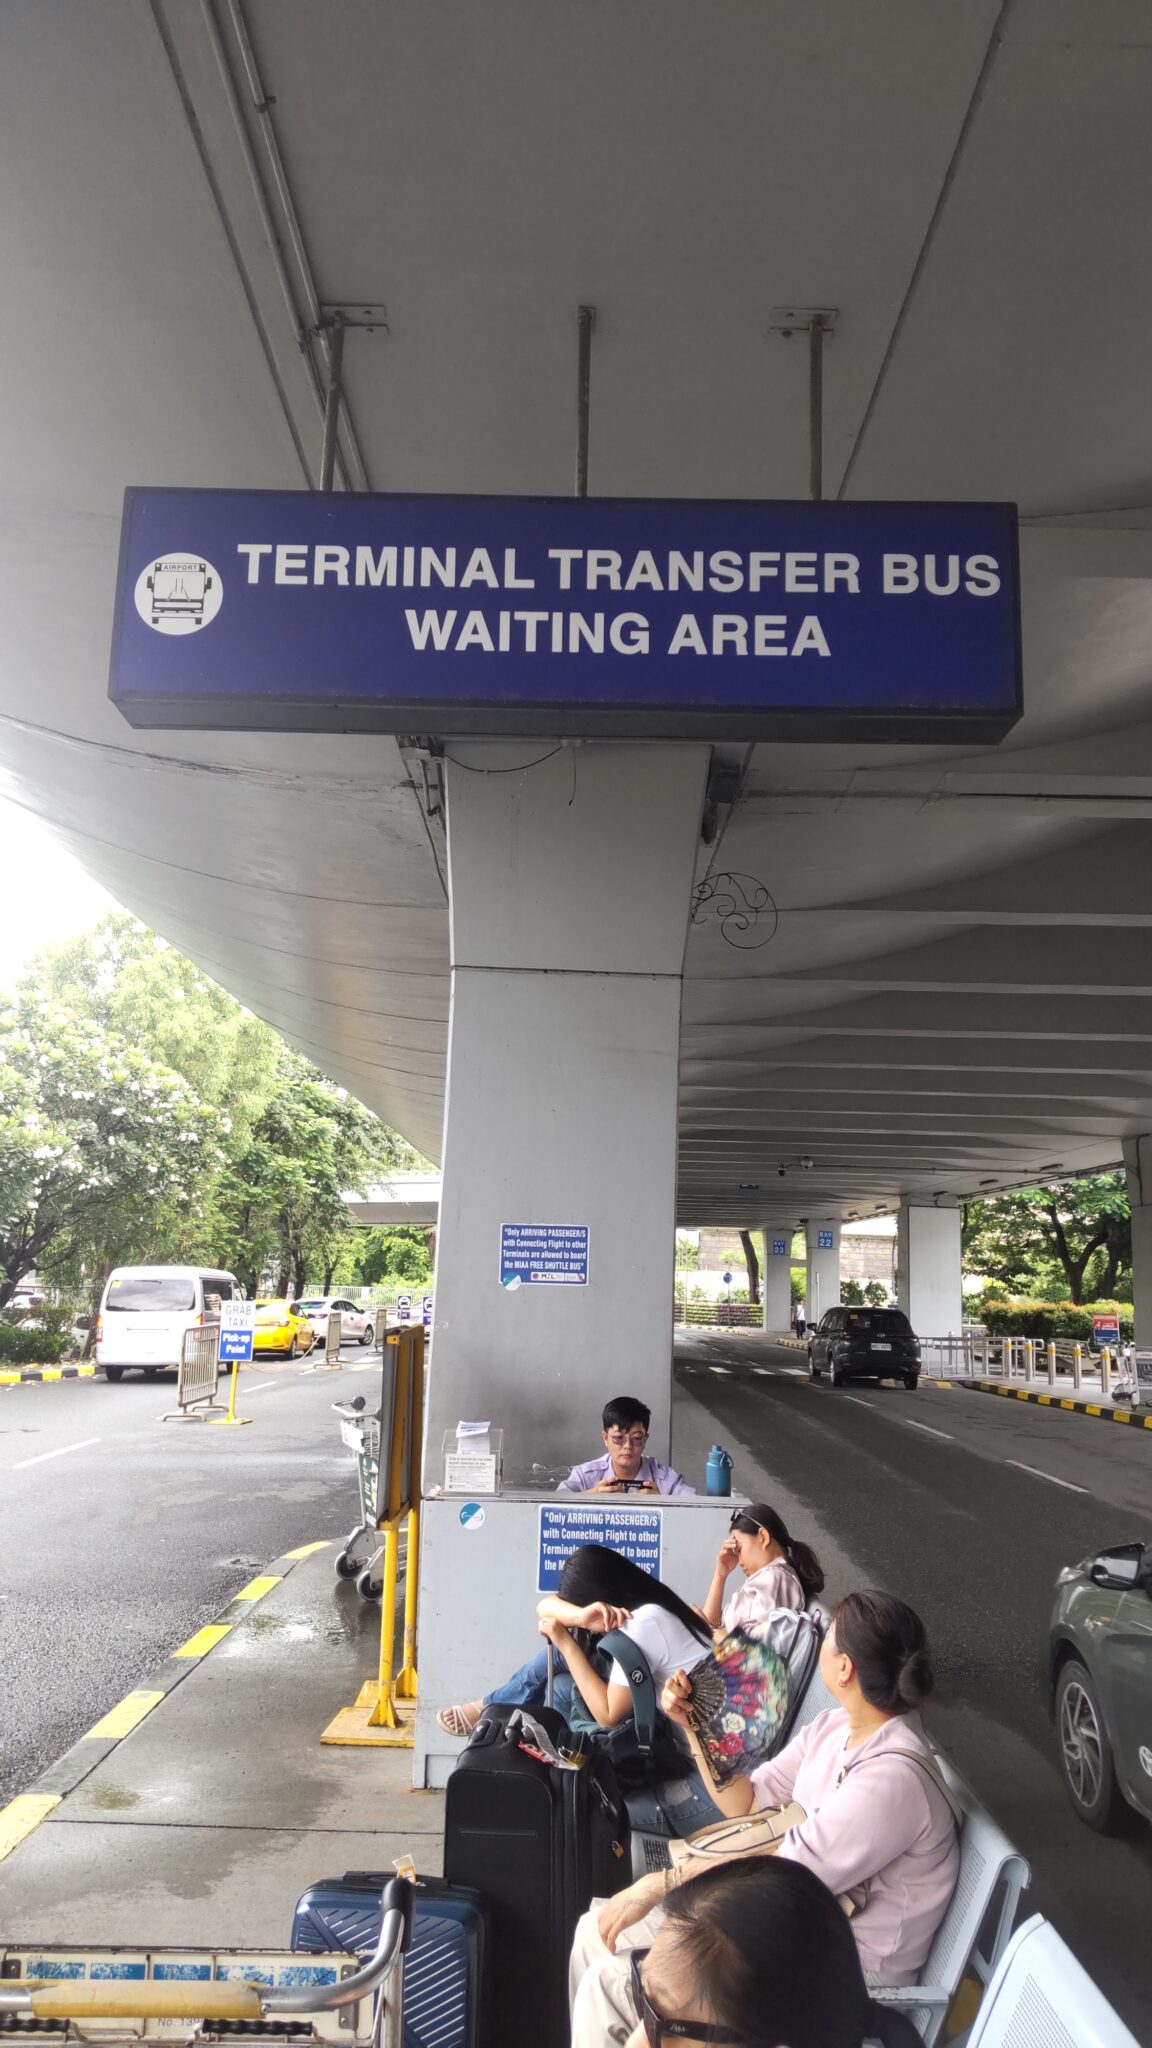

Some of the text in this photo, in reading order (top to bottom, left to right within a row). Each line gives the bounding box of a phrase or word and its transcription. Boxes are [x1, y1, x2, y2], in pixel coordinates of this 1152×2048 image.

[237, 543, 1001, 597] TERMINAL TRANSFER BUS
[404, 609, 832, 657] WAITING AREA
[520, 1228, 547, 1237] ARRIVING
[547, 1229, 586, 1238] PASSENGER/S
[503, 1239, 516, 1247] with
[516, 1239, 547, 1249] Connecting
[548, 1240, 564, 1250] Flight
[571, 1241, 587, 1249] other
[819, 1238, 832, 1247] 22
[503, 1249, 530, 1258] Terminals
[541, 1250, 562, 1259] allowed
[563, 1251, 569, 1259] to
[570, 1251, 586, 1260] board
[774, 1246, 784, 1254] 23
[514, 1261, 529, 1269] MIAA
[529, 1261, 544, 1269] FREE
[544, 1261, 569, 1270] SHUTTLE
[226, 1305, 252, 1316] GRAB
[228, 1317, 249, 1327] TAXI
[222, 1332, 251, 1344] Pick-up
[225, 1344, 246, 1354] Point
[567, 1512, 604, 1525] ARRIVING
[605, 1514, 658, 1527] PASSENGER/S
[543, 1528, 659, 1543] with Connecting Flight to other
[626, 1546, 635, 1557] to
[636, 1547, 658, 1559] board
[544, 1559, 557, 1571] the
